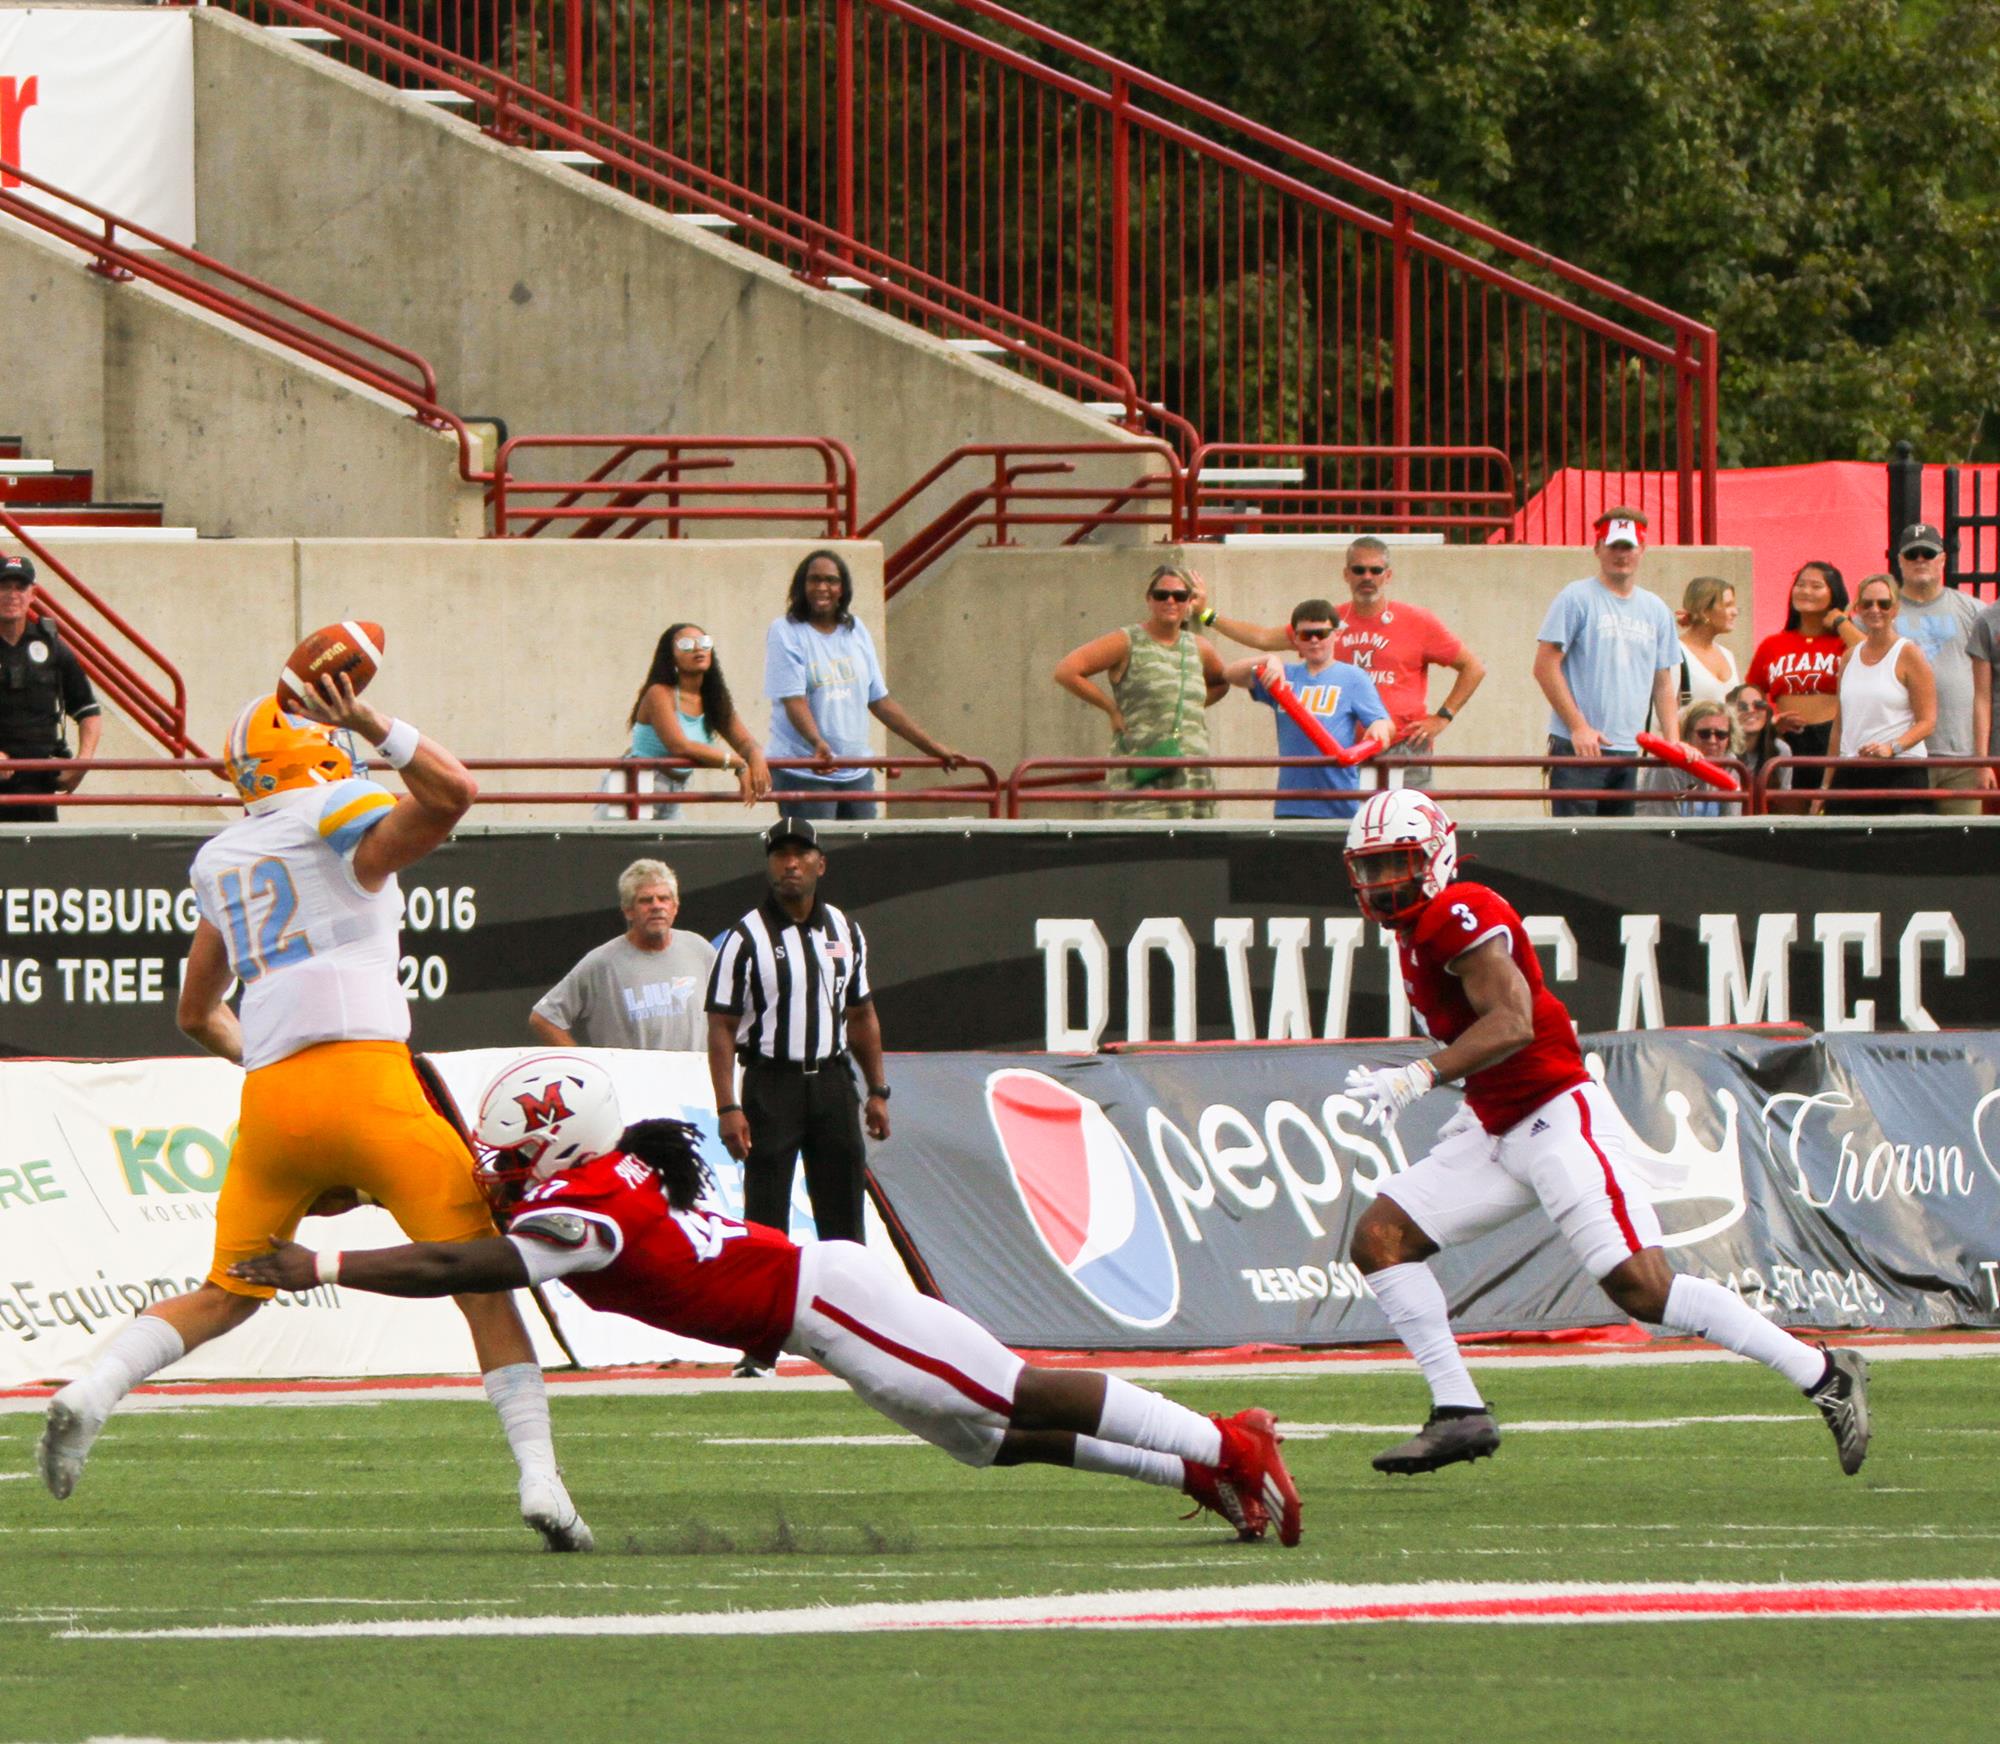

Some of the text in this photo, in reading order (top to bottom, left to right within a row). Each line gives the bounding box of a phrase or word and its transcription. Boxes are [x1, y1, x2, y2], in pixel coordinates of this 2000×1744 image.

[1914, 524, 1926, 537] P
[309, 641, 347, 671] Wilson
[1342, 631, 1390, 649] MIAMI
[1353, 649, 1374, 668] M
[1769, 652, 1840, 685] MIAM
[0, 886, 477, 933] ERSBURG 016
[216, 855, 316, 984] 12
[1451, 903, 1478, 931] 3
[56, 957, 164, 1002] TREE
[623, 981, 672, 1011] LIU
[1035, 911, 1966, 1053] BOW AMES
[512, 1080, 576, 1133] M
[109, 1122, 242, 1196] KO
[1761, 1091, 1975, 1207] Crown
[139, 1201, 217, 1222] KOENI
[1240, 1260, 1378, 1302] ZERO SU
